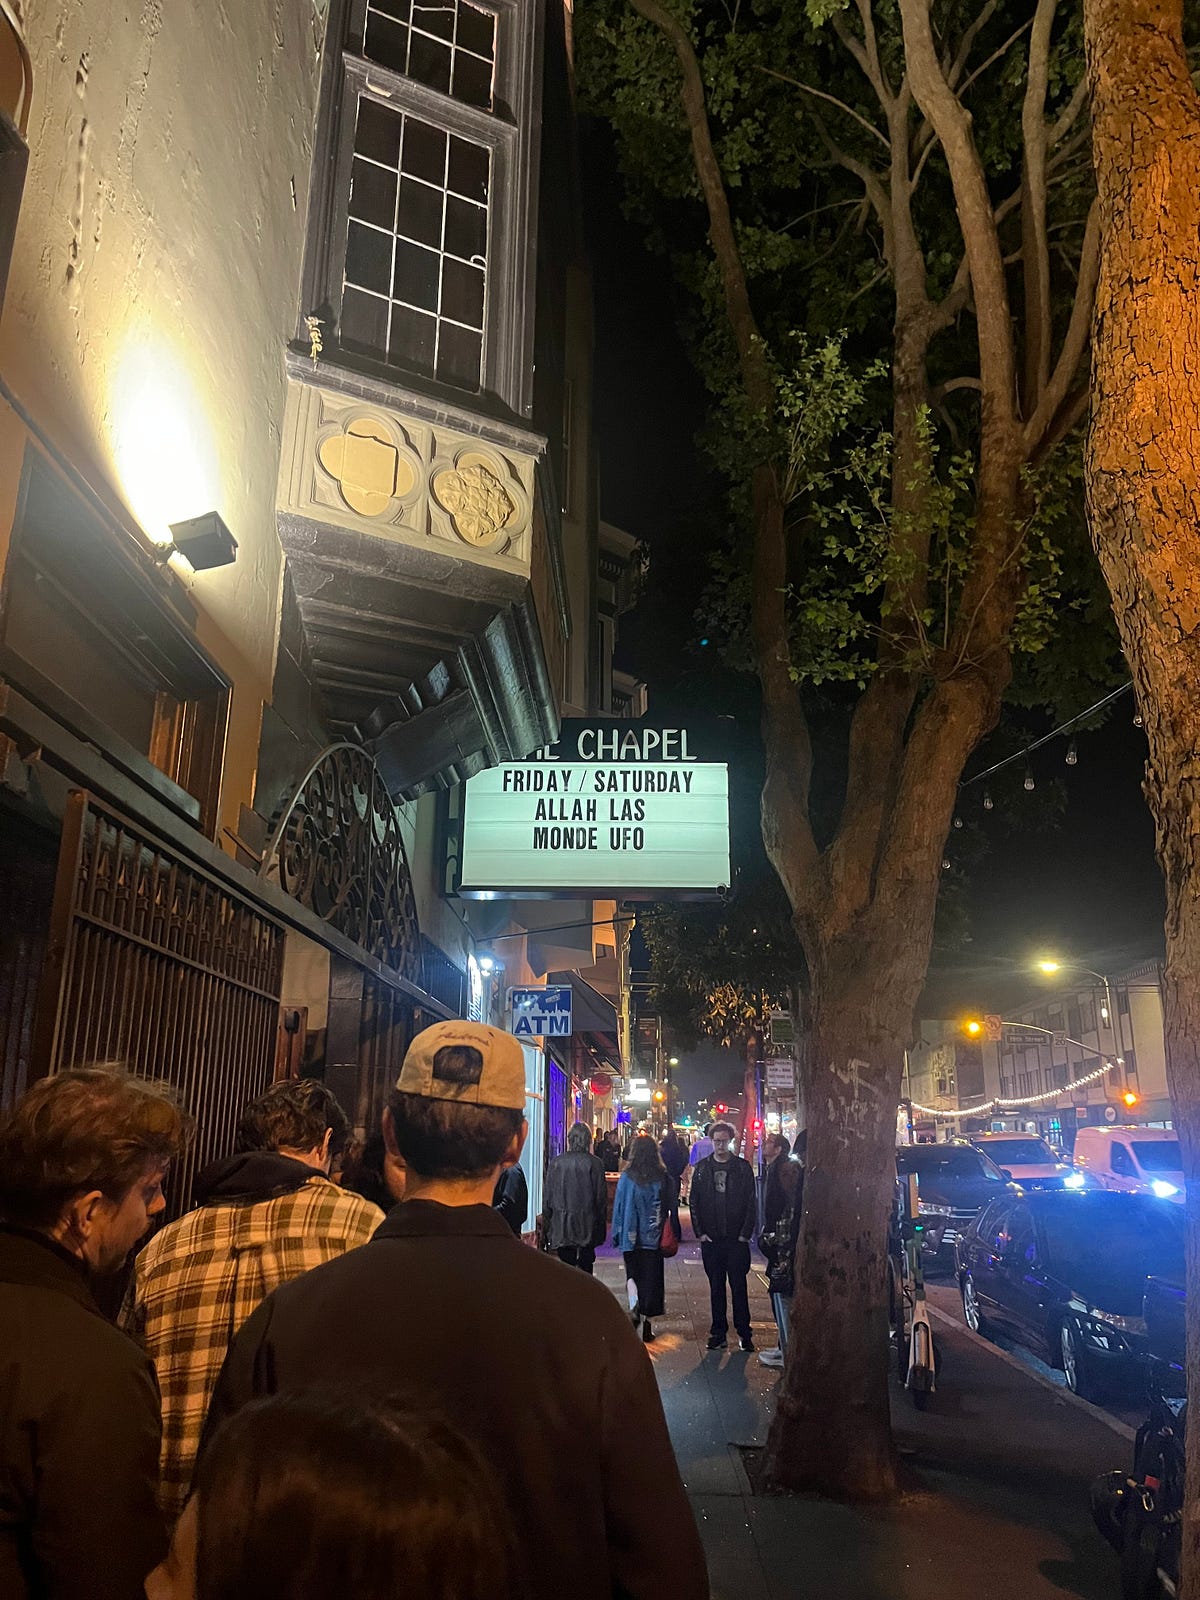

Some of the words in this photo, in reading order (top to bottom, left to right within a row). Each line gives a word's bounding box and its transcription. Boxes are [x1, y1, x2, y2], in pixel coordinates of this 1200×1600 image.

[577, 728, 698, 761] CHAPEL
[502, 769, 572, 792] FRIDAY
[594, 770, 694, 793] SATURDAY
[534, 798, 597, 821] ALLAH
[609, 798, 646, 821] LAS
[533, 826, 598, 850] MONDE
[609, 826, 645, 850] UFO
[514, 1015, 569, 1034] ATM
